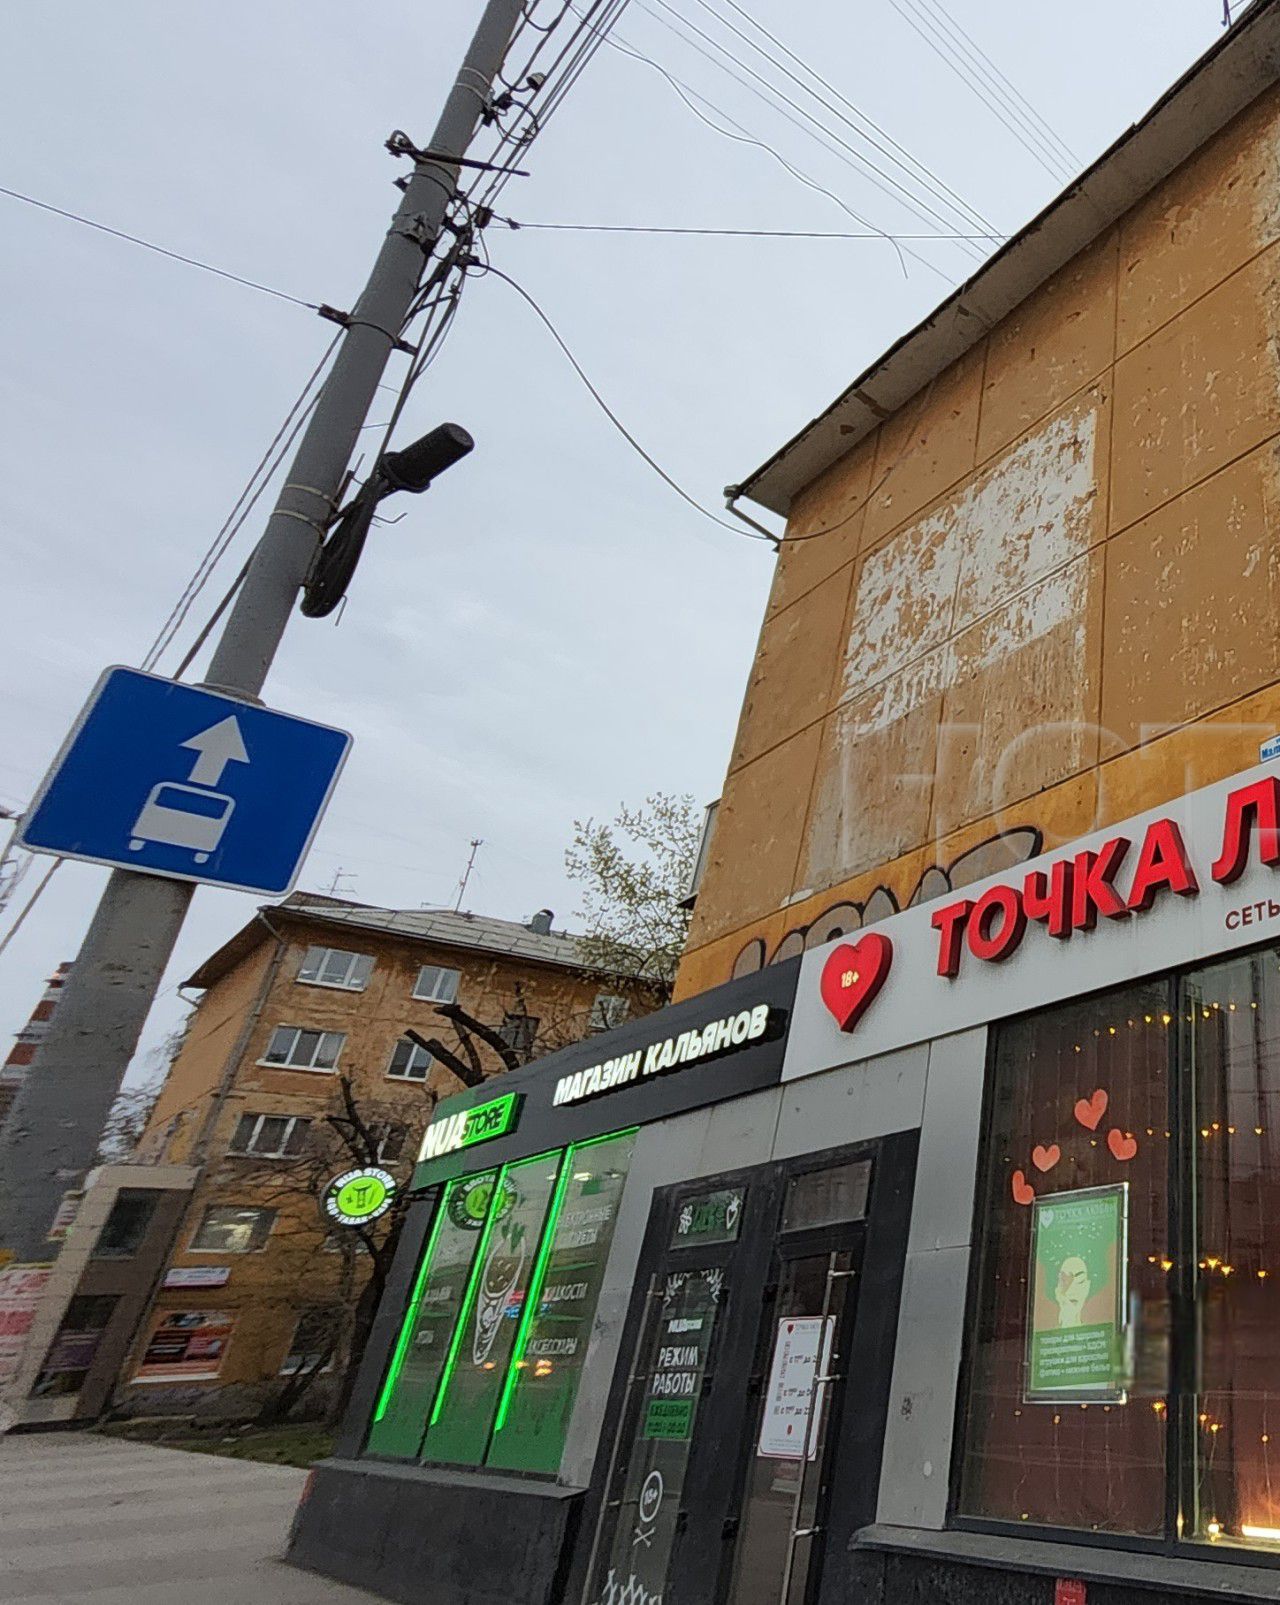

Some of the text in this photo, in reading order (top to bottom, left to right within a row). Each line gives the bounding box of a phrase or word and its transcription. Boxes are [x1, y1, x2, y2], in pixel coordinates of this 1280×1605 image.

[931, 817, 1200, 978] ТОЧКА
[1225, 898, 1280, 931] СЕТЬ
[841, 970, 859, 988] 18+
[552, 1004, 770, 1107] МАГАЗИН КАЛЬЯНОВ
[461, 1103, 506, 1141] STORE
[658, 1346, 699, 1368] РЕЖИМ
[652, 1372, 697, 1395] РАБОТЫ
